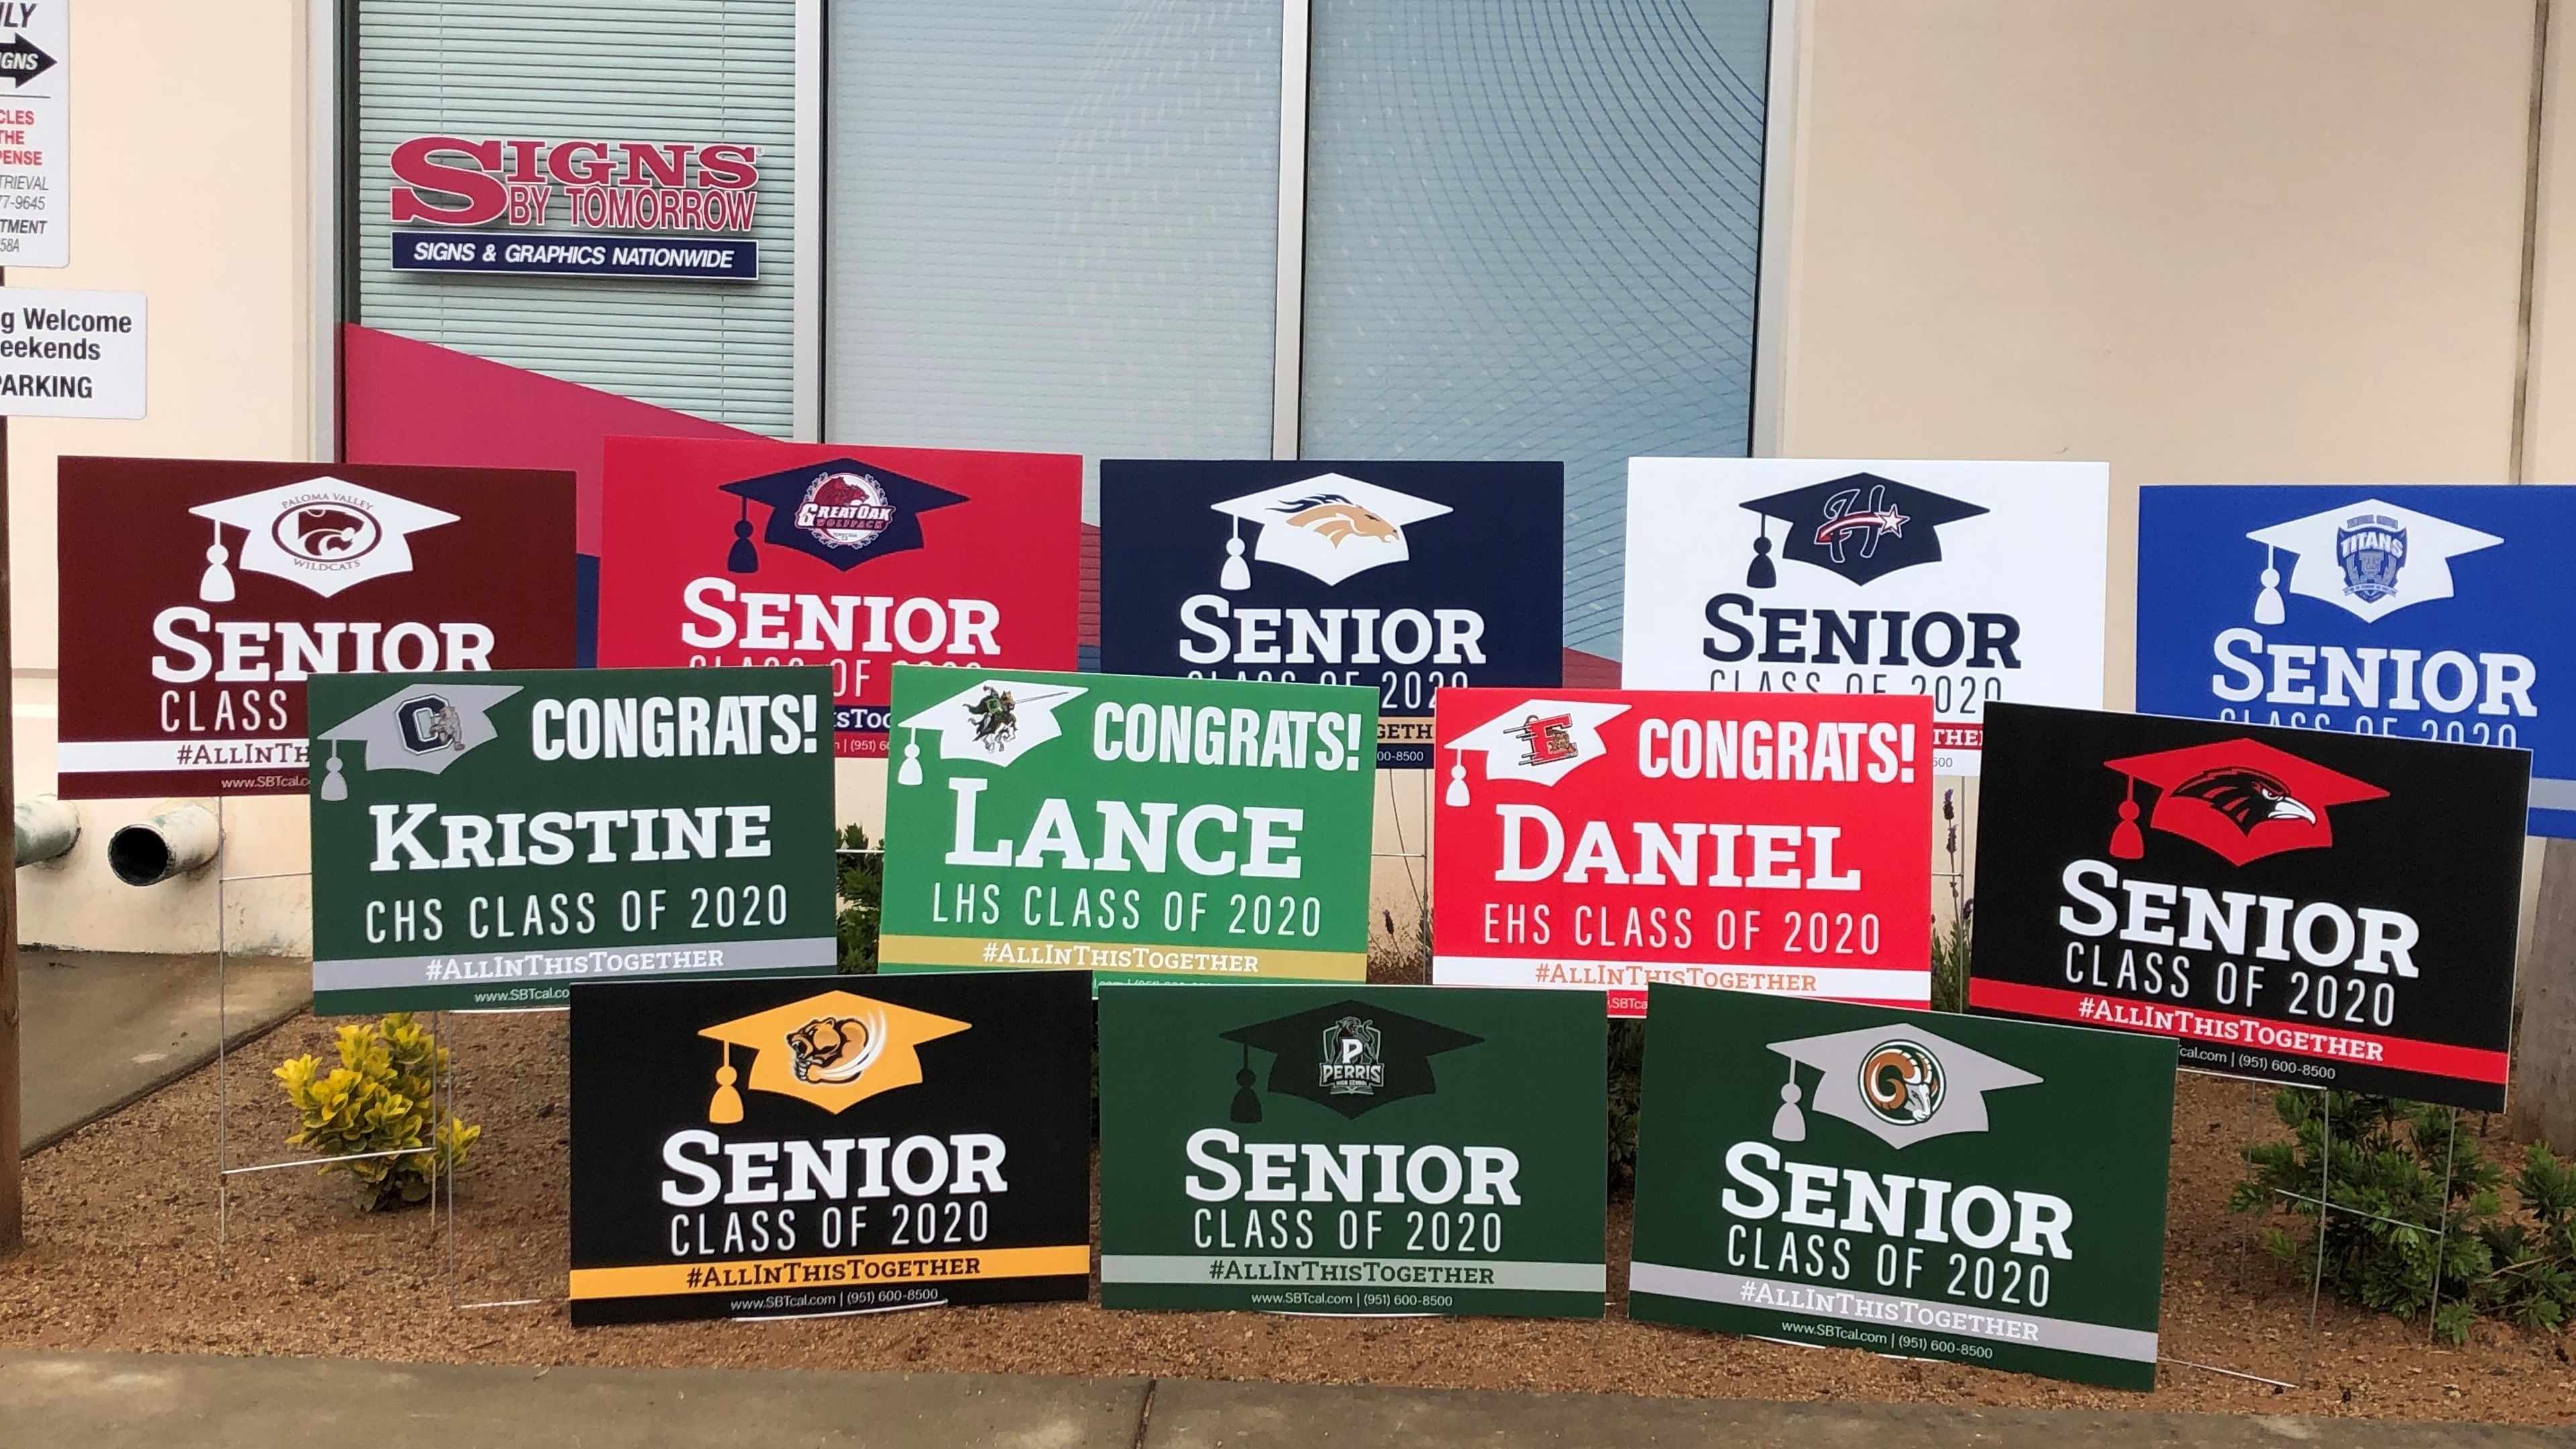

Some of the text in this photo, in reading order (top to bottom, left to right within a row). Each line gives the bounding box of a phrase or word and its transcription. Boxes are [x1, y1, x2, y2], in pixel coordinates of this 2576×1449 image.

[391, 136, 758, 226] SIGNS
[509, 185, 757, 232] BY TOMORROW
[413, 242, 735, 268] SIGNS & GRAPHICS NATIONWIDE
[23, 307, 132, 333] Welcome
[1, 336, 101, 360] eekends
[0, 374, 93, 399] ARKING
[281, 493, 374, 510] PALOMA VALLEY
[293, 558, 361, 571] WILDCATS
[2340, 531, 2404, 558] TITANS
[682, 577, 1001, 655] SENIOR
[1179, 594, 1486, 664] SENIOR
[1703, 593, 2021, 669] SENIOR
[152, 607, 495, 683] SENIOR
[2213, 628, 2537, 717] SENIOR
[161, 689, 287, 732] CLASS
[532, 694, 818, 761] CONGRATS!
[1093, 701, 1362, 771] CONGRATS!
[850, 739, 876, 752] (951)
[1638, 718, 1916, 783] CONGRATS!
[369, 803, 771, 872] KRISTINE
[945, 777, 1304, 879] LANCE
[1495, 803, 1861, 891] DANIEL
[366, 885, 787, 943] CHS CLASS OF 2020
[933, 882, 1321, 937] LHS CLASS OF 2020
[1484, 903, 1879, 955] EHS CLASS OF 2020
[2059, 859, 2420, 979] SENIOR
[426, 948, 724, 981] #ALLINTHISTOGETHER
[983, 942, 1258, 972] #ALLINTHISTOGETHER
[1535, 962, 1817, 992] #ALLINTHISTOGETHER
[2065, 942, 2395, 1028] CLASS OF 2020
[1342, 1038, 1363, 1064] P
[2079, 997, 2384, 1062] #ALLINTHISTOGETHER
[1322, 1064, 1381, 1083] PERRIS
[2238, 1053, 2268, 1071] (951)
[2271, 1060, 2336, 1080] 600-8500
[661, 1129, 1007, 1207] SENIOR
[1185, 1128, 1521, 1205] SENIOR
[1722, 1142, 2073, 1260] SENIOR
[671, 1201, 989, 1256] CLASS OF 2020
[1195, 1208, 1502, 1252] CLASS OF 2020
[687, 1257, 981, 1289] #ALLINTHISTOGETHER
[1209, 1259, 1494, 1285] #ALLINTHISTOGETHER
[1728, 1224, 2050, 1307] CLASS OF 2020
[730, 1293, 836, 1311] www.SBTcal.com
[847, 1291, 875, 1305] (951)
[878, 1288, 938, 1303] 600-8500
[1251, 1292, 1352, 1305] www.SBTcal.com
[1363, 1293, 1391, 1307] (951)
[1394, 1295, 1452, 1307] 600-8500
[1740, 1280, 2039, 1341] #ALLINTHISTOGETHER
[1781, 1321, 1887, 1344] www.SBTcal.com
[1898, 1334, 1928, 1351] (951)
[1931, 1340, 1993, 1358] 600-8500
